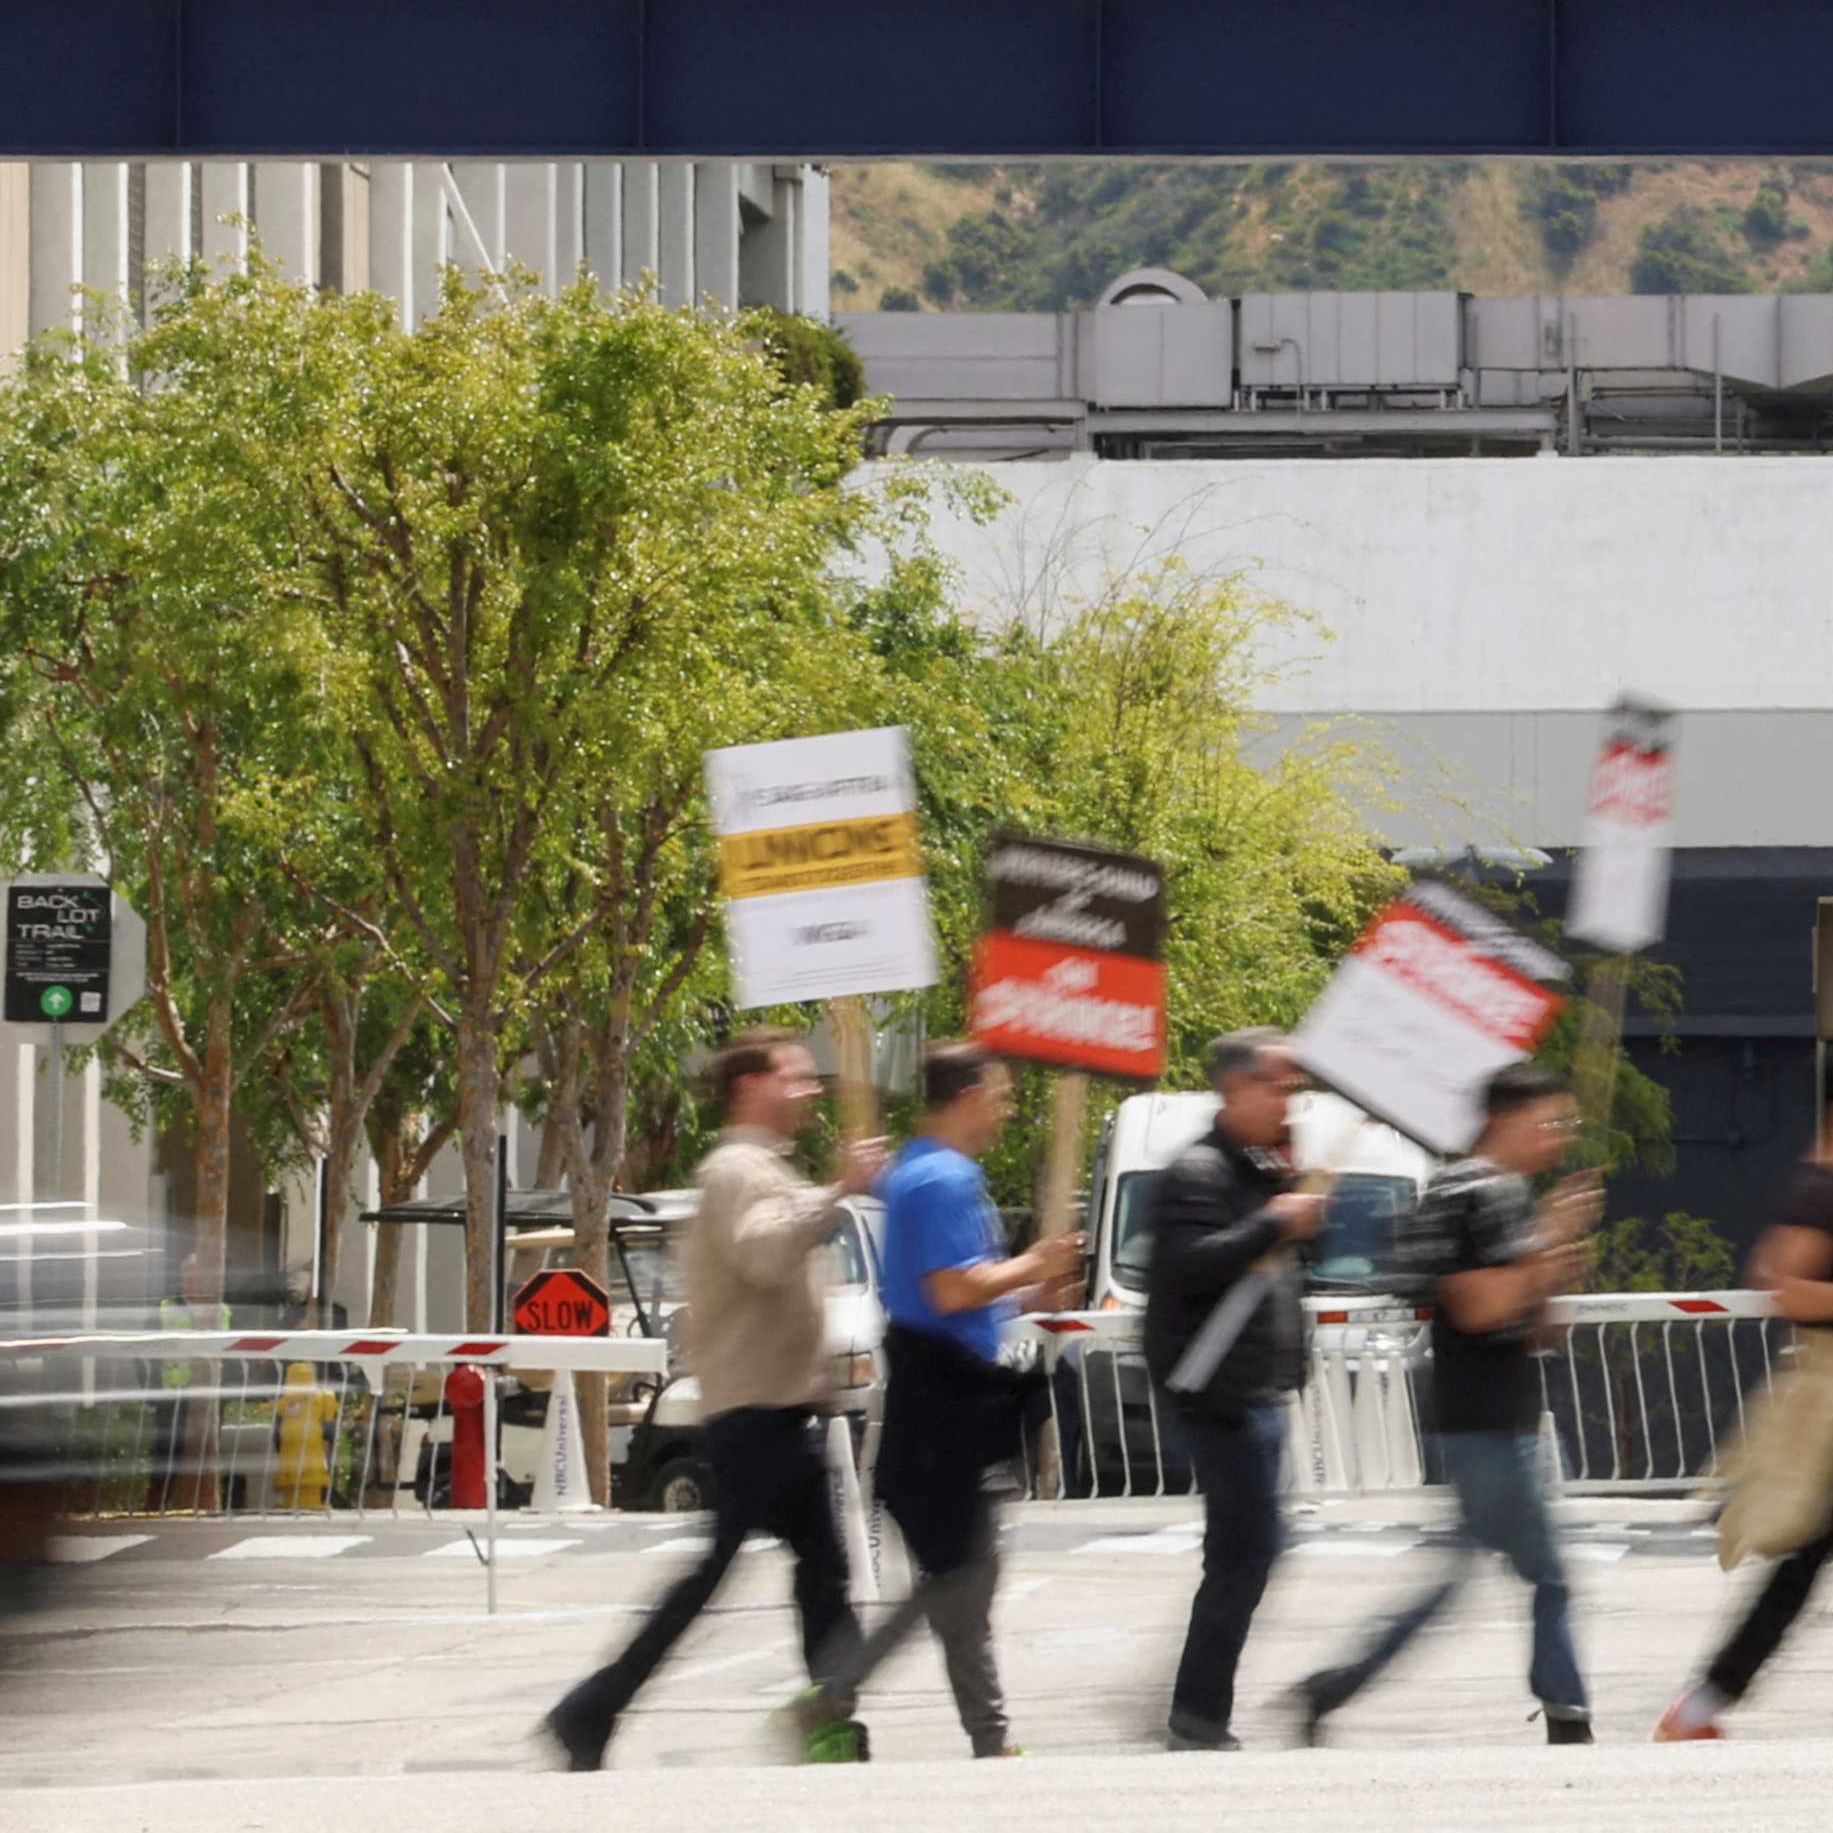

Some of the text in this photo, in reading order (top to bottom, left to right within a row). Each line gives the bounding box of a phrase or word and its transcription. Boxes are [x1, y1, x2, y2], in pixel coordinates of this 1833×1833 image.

[17, 895, 79, 909] BACK
[57, 909, 99, 923] LOT
[16, 924, 85, 939] TRAIL
[526, 1301, 593, 1331] SLOW
[555, 1395, 568, 1497] NBCUniversal
